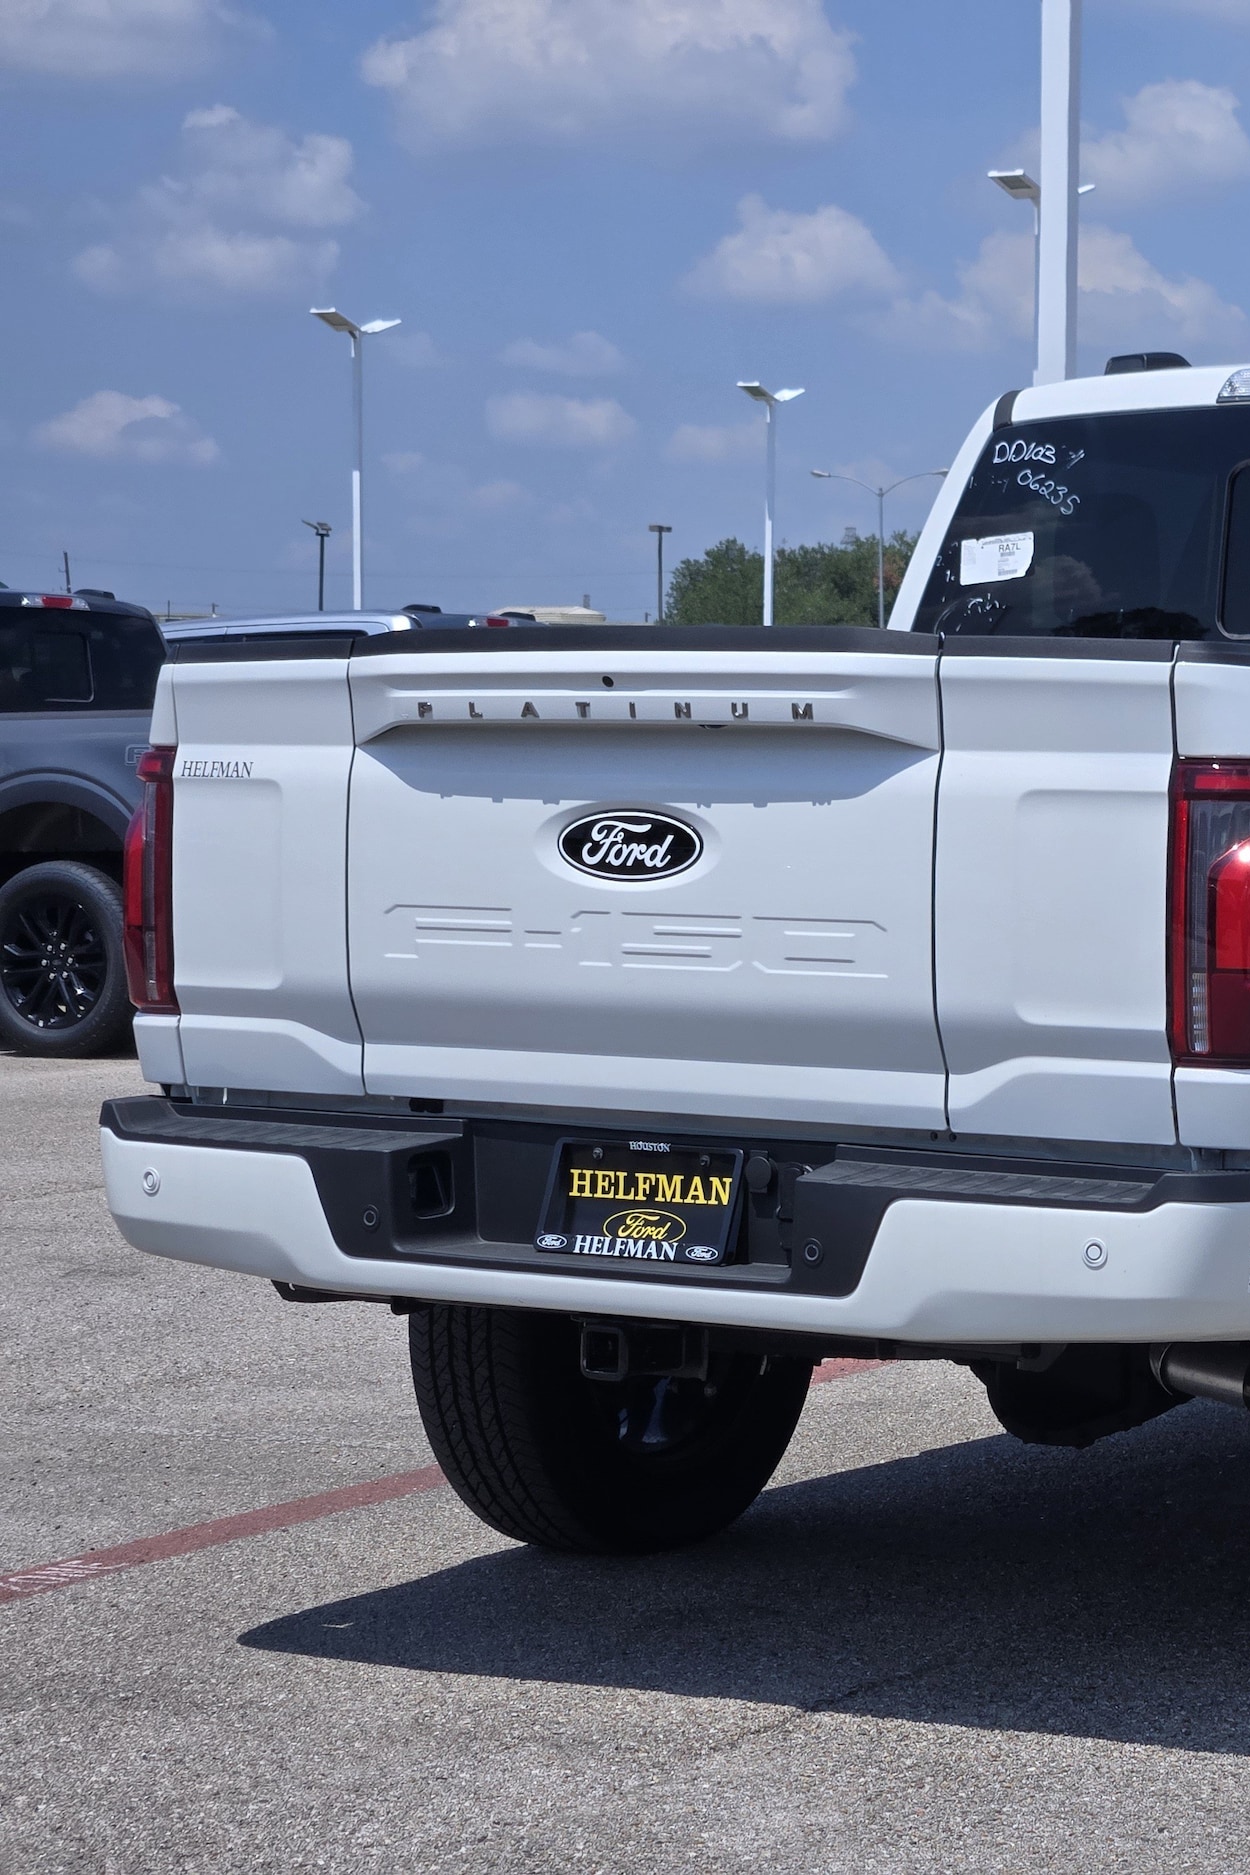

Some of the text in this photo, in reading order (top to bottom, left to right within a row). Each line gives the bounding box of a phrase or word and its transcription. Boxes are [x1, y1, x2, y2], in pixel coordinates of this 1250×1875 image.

[1017, 469, 1081, 515] 06235
[417, 701, 814, 720] PLATINUM
[181, 760, 254, 778] HELFMAN
[581, 819, 674, 869] Ford
[384, 903, 889, 979] F-150
[629, 1141, 671, 1153] HOUSTON
[569, 1168, 733, 1206] HELFMAN
[617, 1212, 672, 1240] Ford
[573, 1234, 678, 1261] HELFMAN
